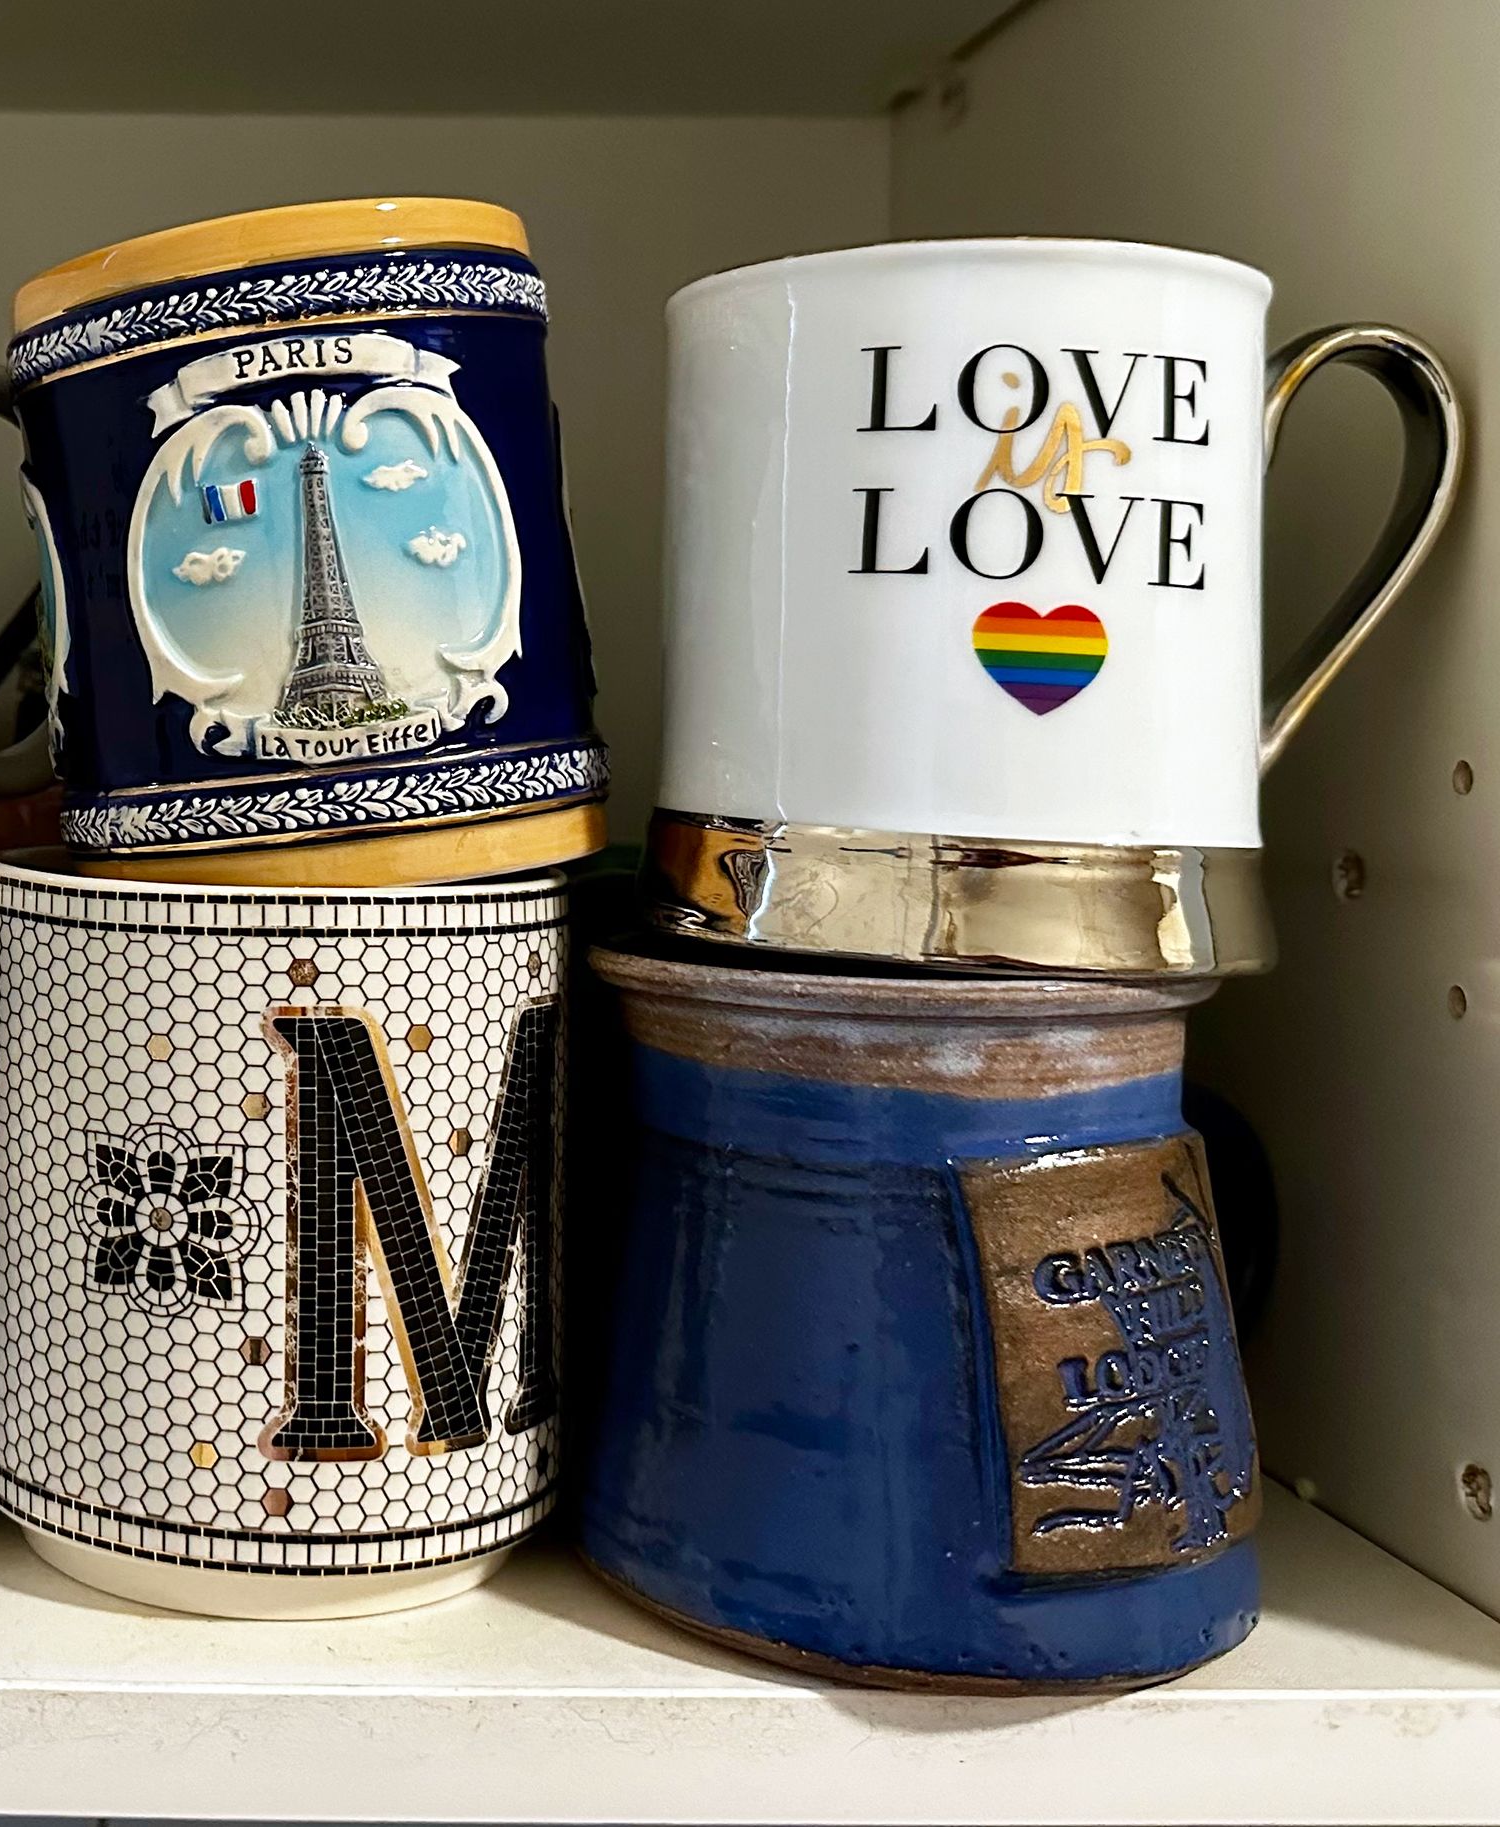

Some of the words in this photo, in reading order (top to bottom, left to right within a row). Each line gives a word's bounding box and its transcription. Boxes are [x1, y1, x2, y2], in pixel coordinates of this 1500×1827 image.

[232, 337, 353, 379] PARIS
[856, 343, 1210, 447] LOVE
[973, 372, 1132, 513] is
[847, 487, 1206, 592] LOVE
[366, 718, 438, 753] Eiffel
[259, 994, 560, 1461] M
